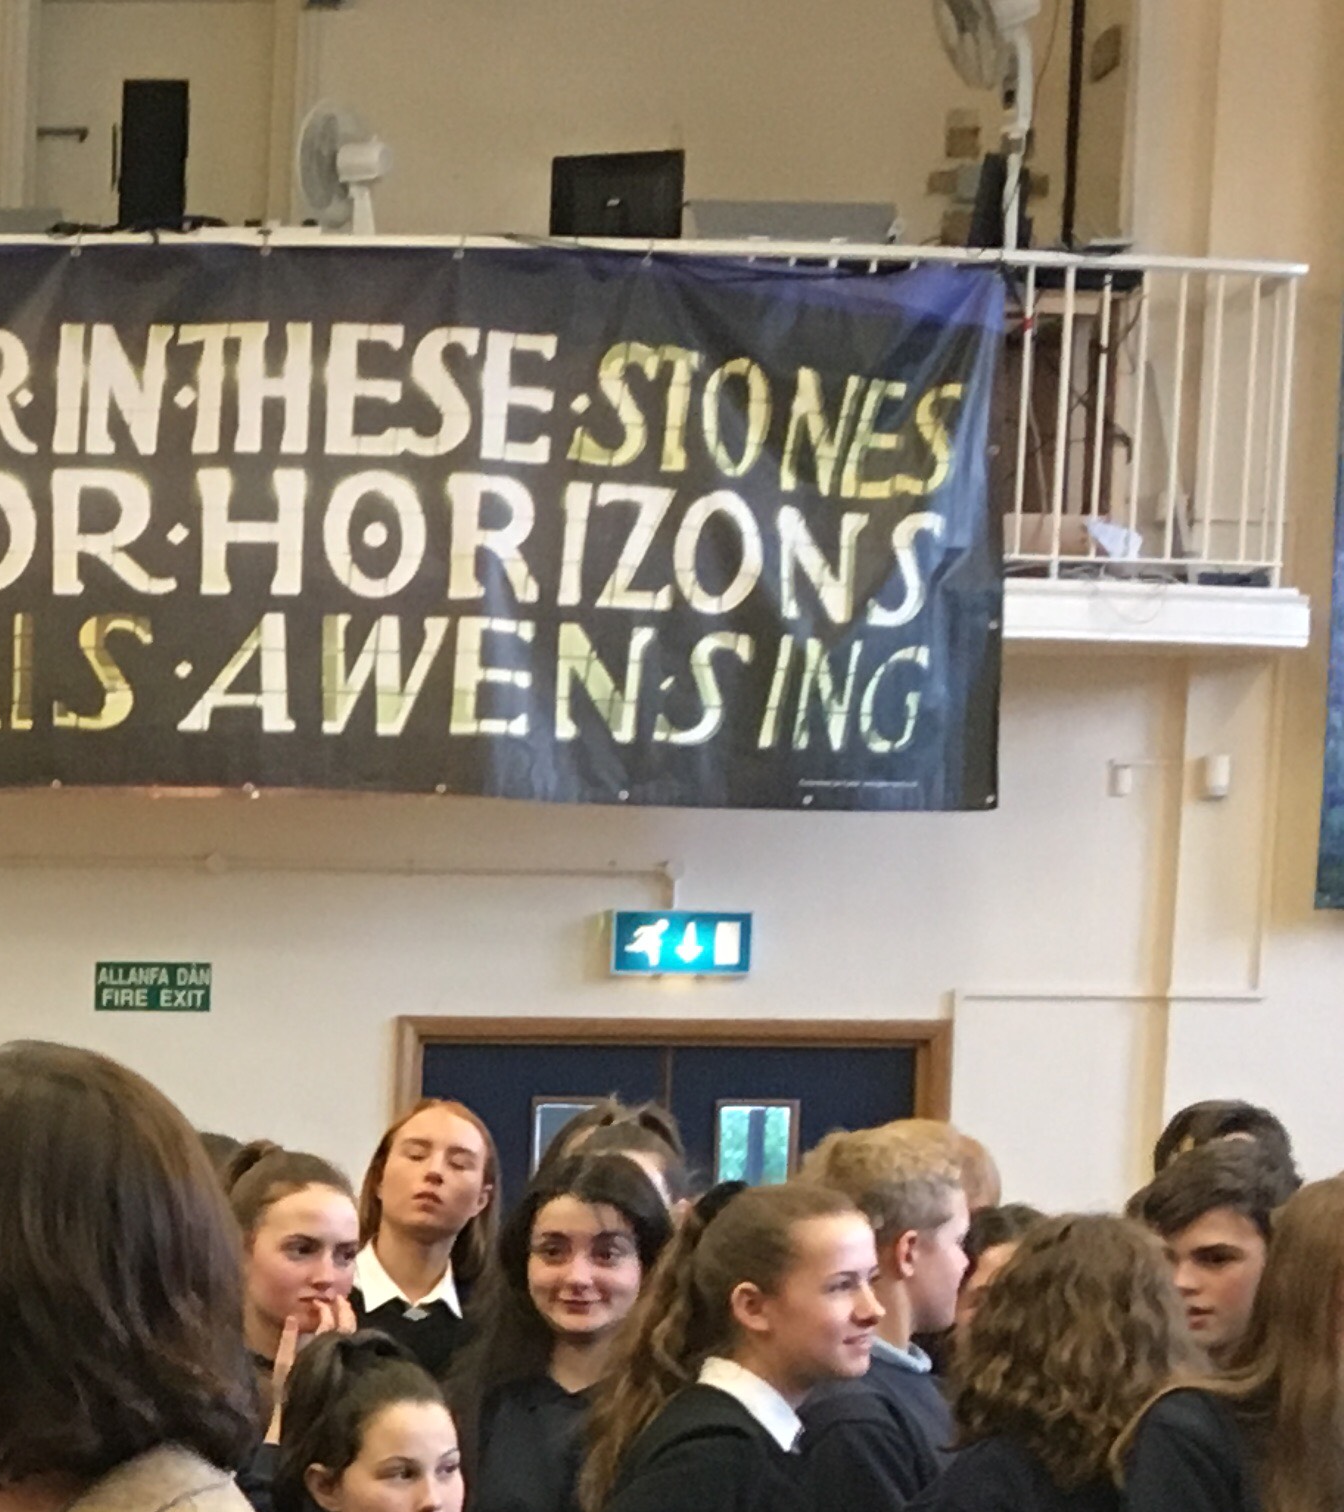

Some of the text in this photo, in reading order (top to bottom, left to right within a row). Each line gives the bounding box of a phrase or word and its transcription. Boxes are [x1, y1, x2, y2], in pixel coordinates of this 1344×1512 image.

[52, 323, 174, 456] IN
[178, 321, 558, 465] THESE
[566, 341, 964, 499] STONES
[196, 467, 947, 628] HORIZONS
[652, 630, 931, 754] SING
[97, 966, 170, 986] ALLANFA
[101, 988, 205, 1009] FIRE EXIT
